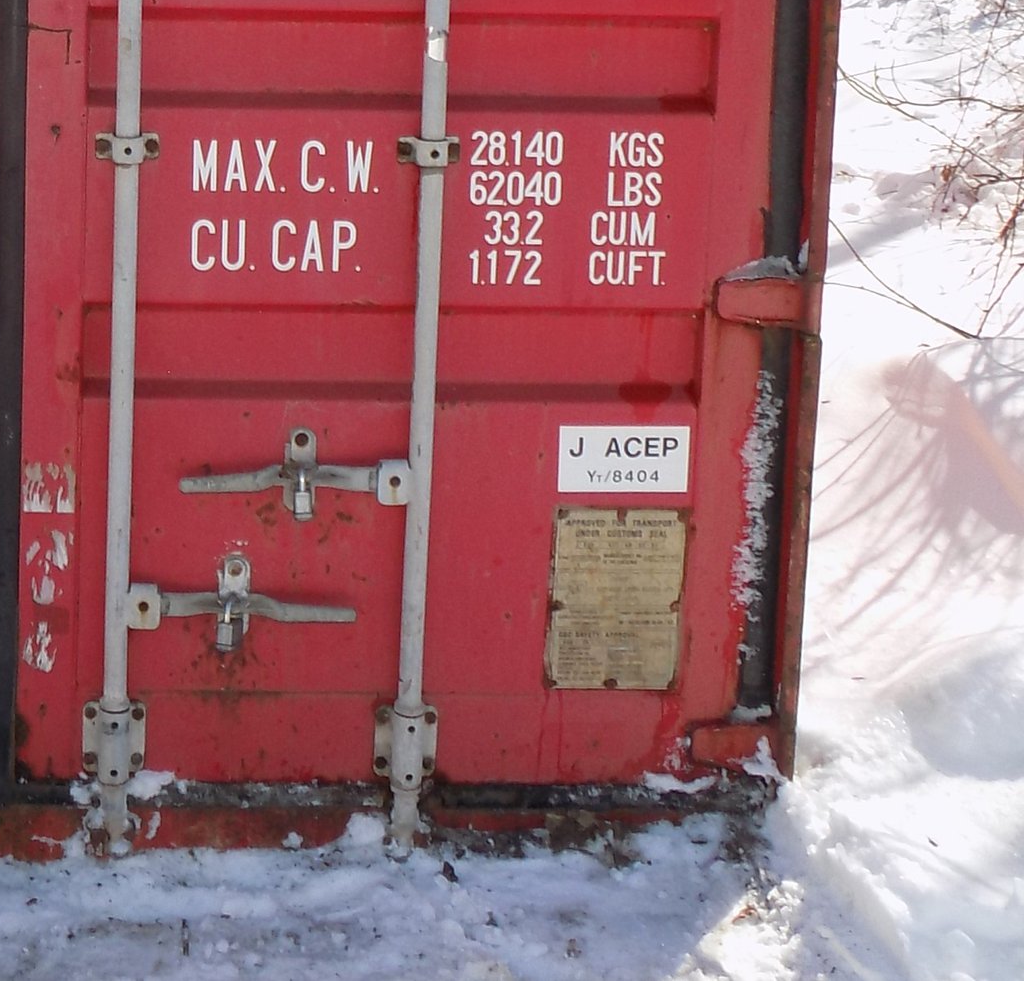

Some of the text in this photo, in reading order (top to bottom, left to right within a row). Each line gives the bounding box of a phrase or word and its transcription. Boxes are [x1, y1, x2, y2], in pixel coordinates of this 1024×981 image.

[192, 139, 286, 193] MAX.
[470, 130, 665, 168] 28.140 KGS
[607, 171, 663, 207] LBS
[191, 218, 361, 272] CU. CAP.
[484, 209, 544, 246] 33.2
[469, 249, 542, 286] 1.172
[569, 437, 679, 458] J ACEP
